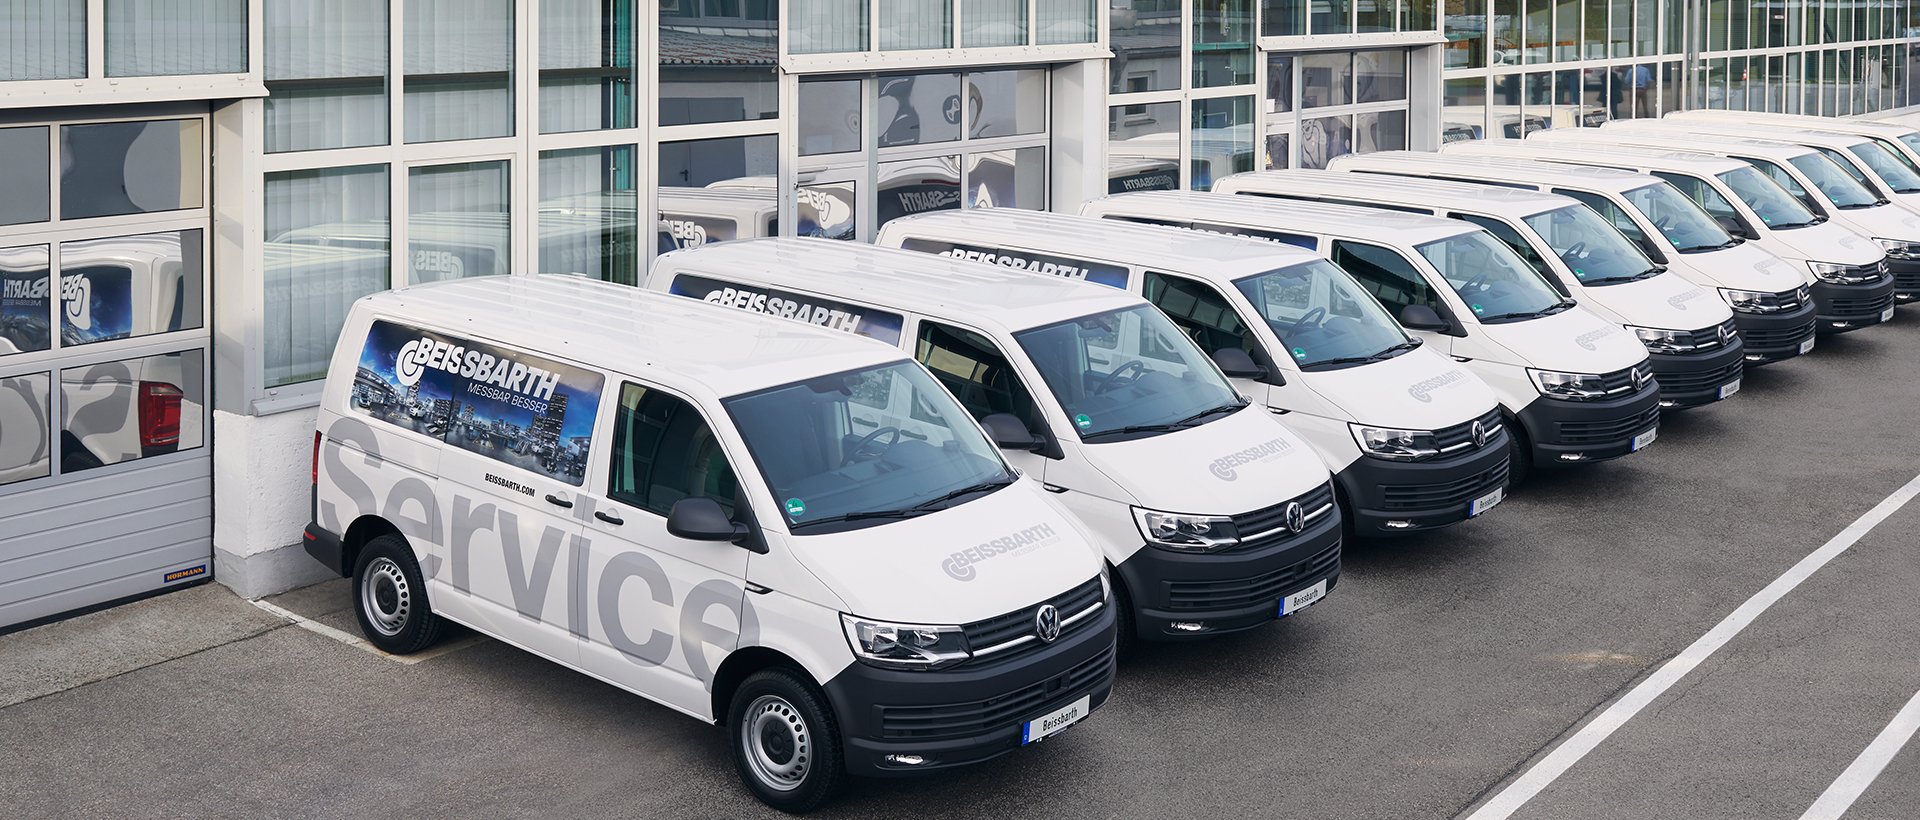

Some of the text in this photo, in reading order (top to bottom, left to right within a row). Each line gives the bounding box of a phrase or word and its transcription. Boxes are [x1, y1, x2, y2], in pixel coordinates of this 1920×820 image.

[412, 336, 561, 401] BEISSBARTH
[467, 382, 548, 415] MESSBAR BESSER
[1213, 437, 1292, 471] BEISSBARTH
[484, 472, 536, 497] BEISSBARTH.COM
[321, 416, 761, 693] Service
[950, 521, 1057, 568] BEISSBARTH
[1042, 706, 1078, 732] Beissbarth
